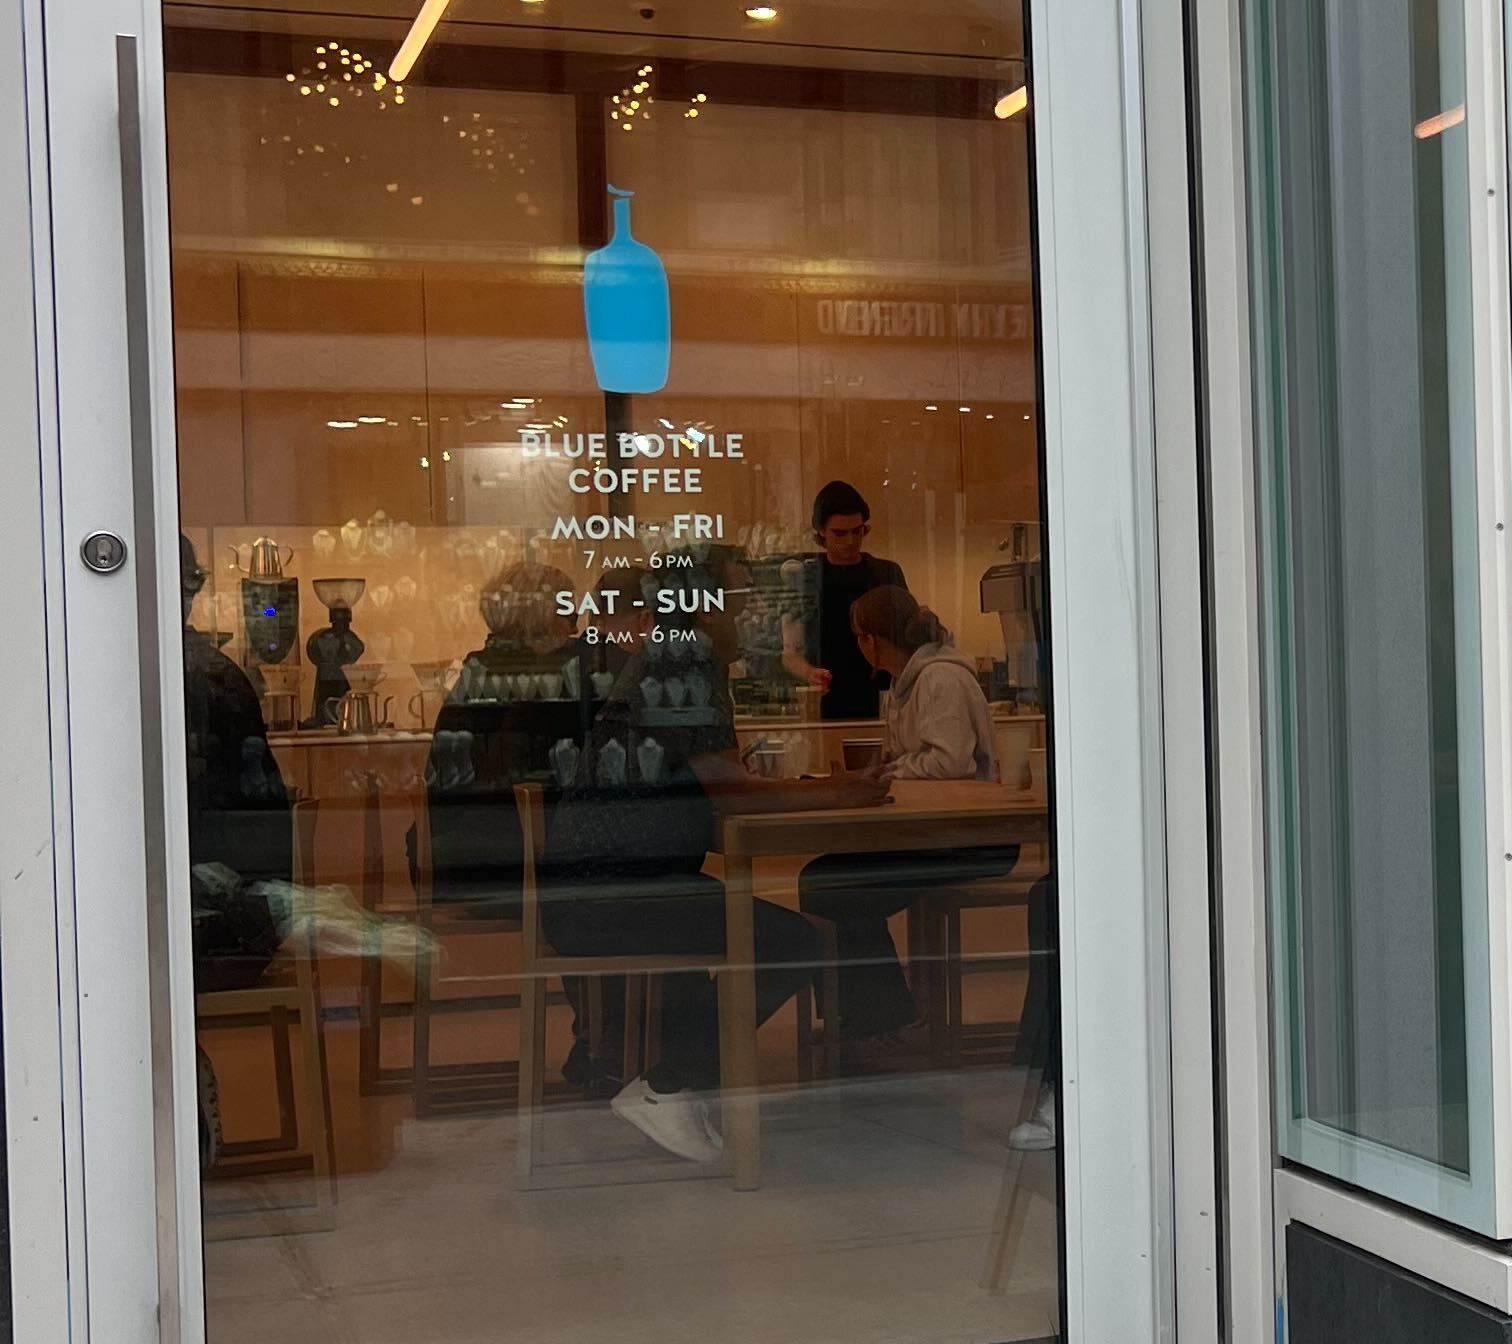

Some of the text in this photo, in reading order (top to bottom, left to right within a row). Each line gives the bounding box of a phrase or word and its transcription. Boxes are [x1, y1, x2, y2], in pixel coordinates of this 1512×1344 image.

[520, 433, 744, 458] BLUE BOTTLE
[569, 469, 702, 493] COFFEE
[551, 514, 635, 539] MON
[673, 514, 723, 538] FRI
[583, 550, 595, 569] 7
[602, 556, 630, 569] AM
[555, 590, 620, 616] SAT
[656, 587, 725, 613] SUN
[585, 626, 599, 645] 8
[605, 631, 634, 644] AM
